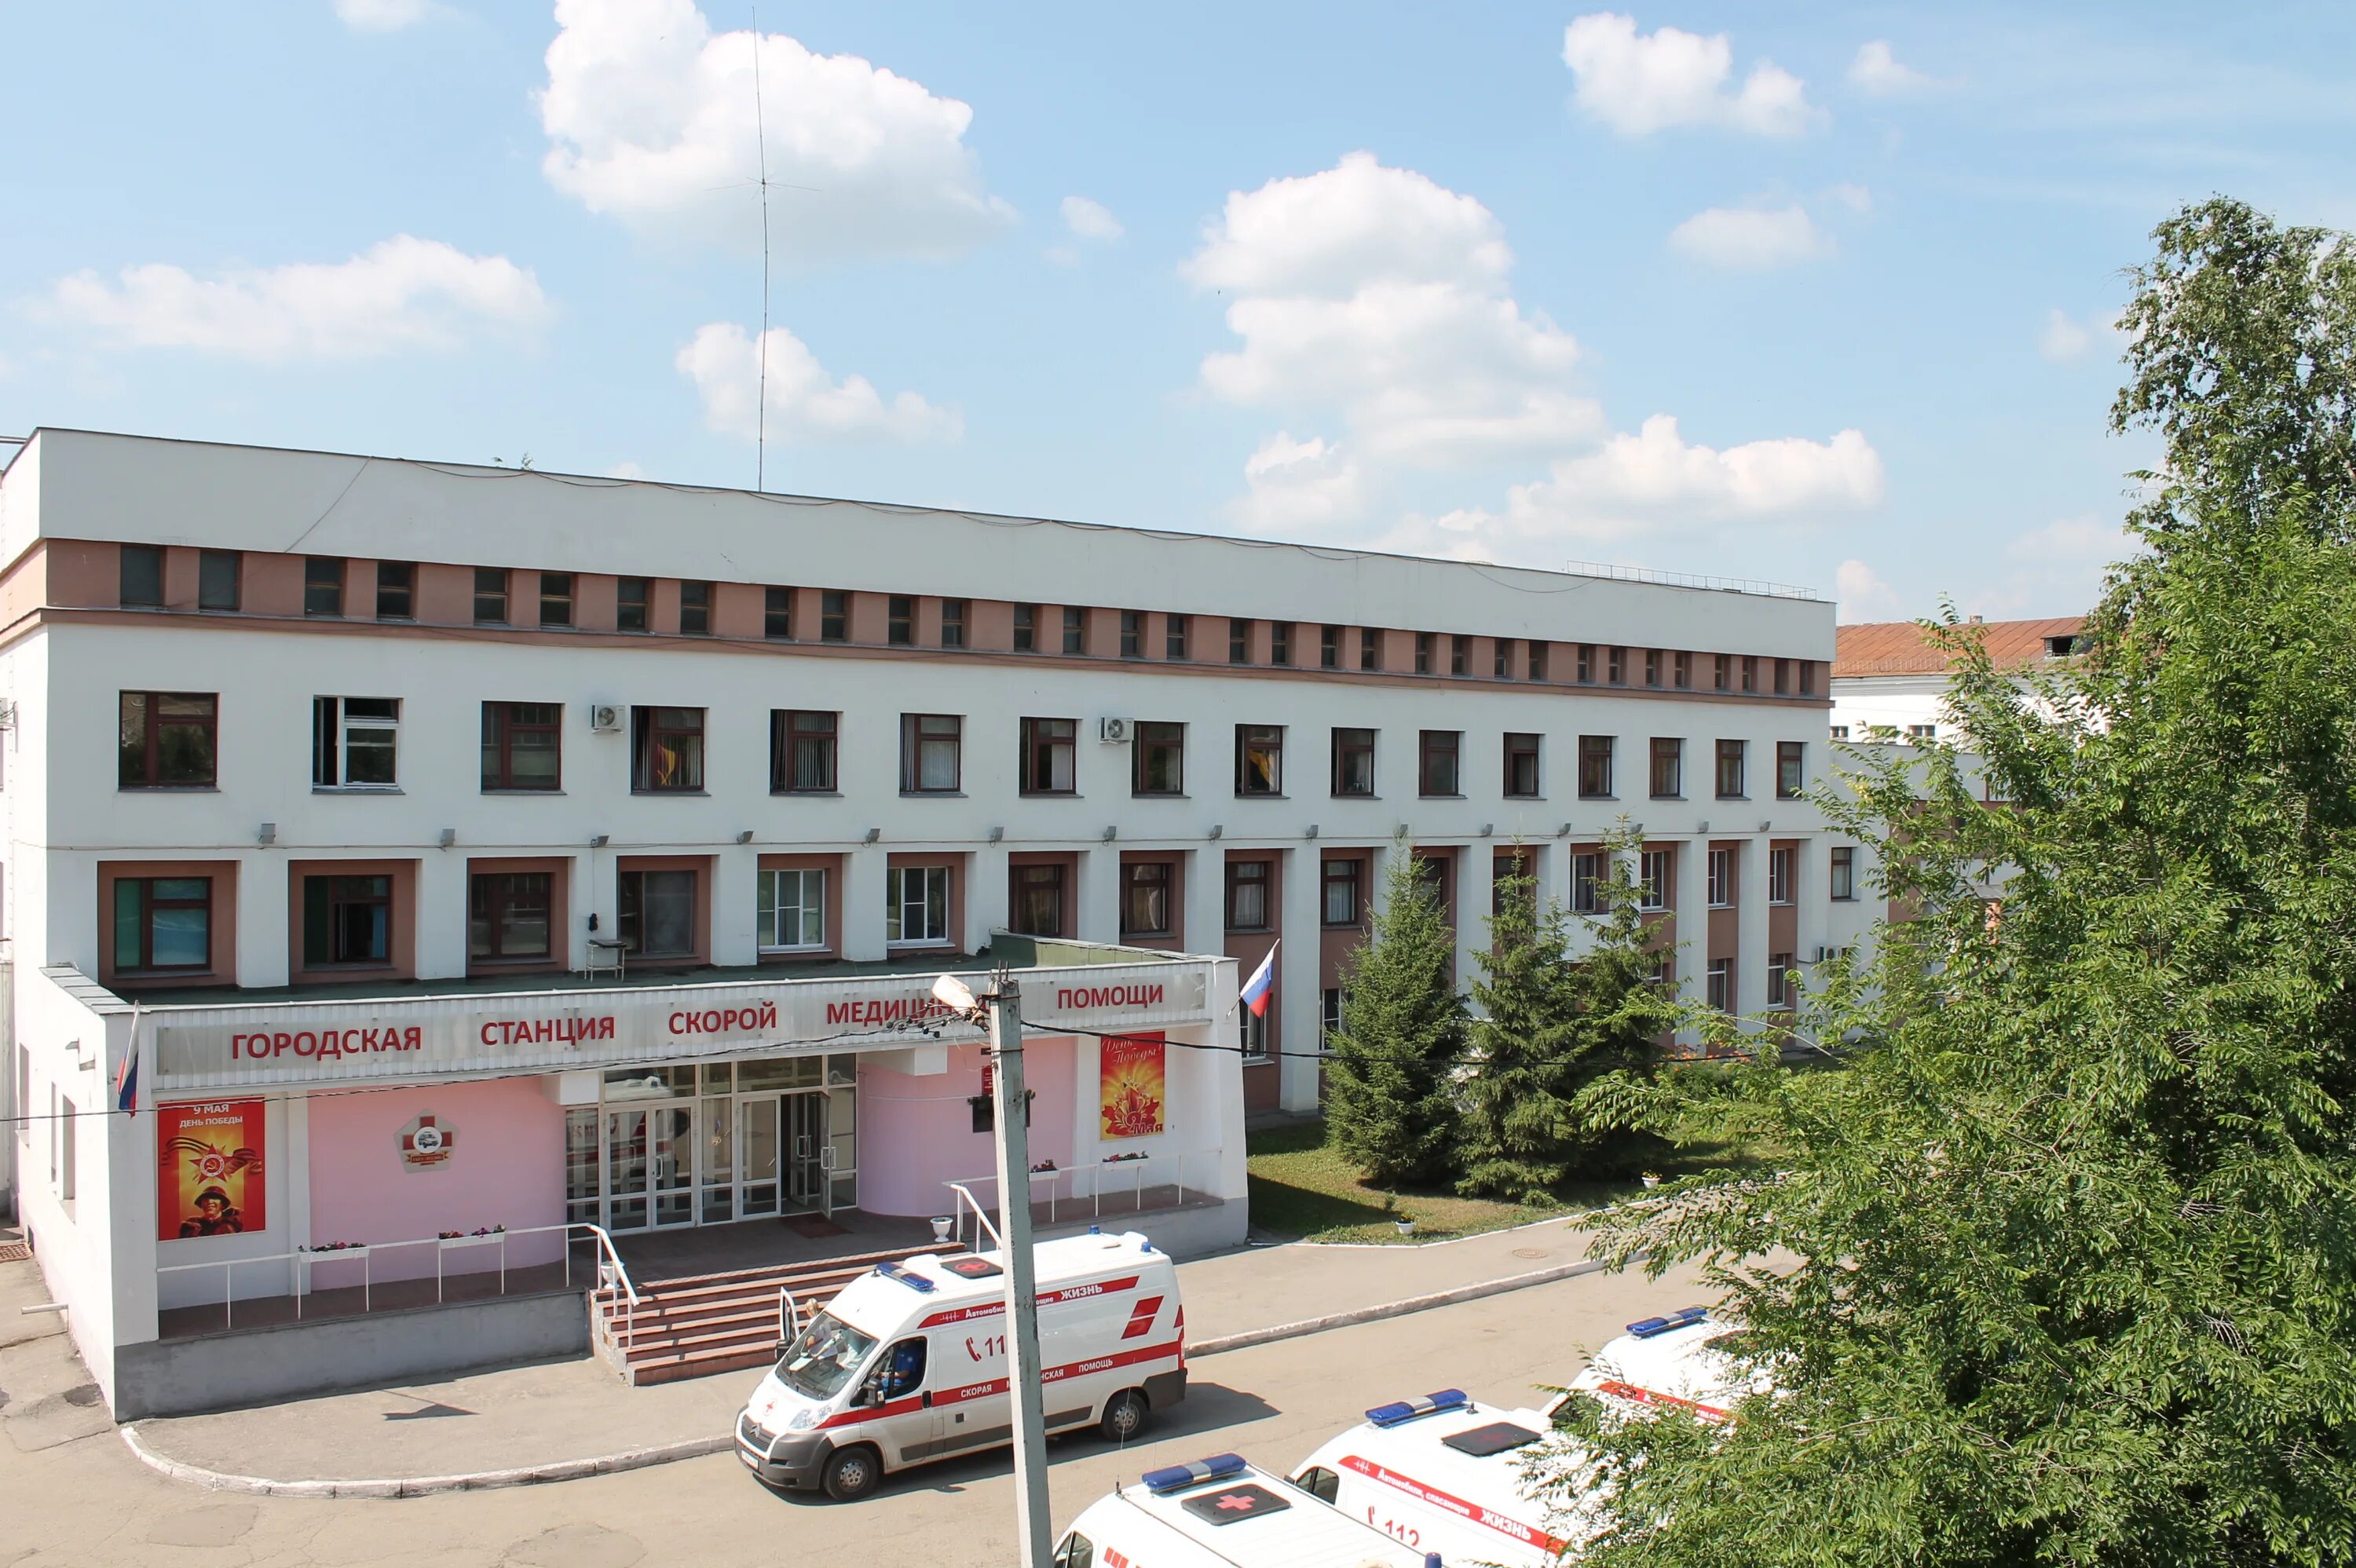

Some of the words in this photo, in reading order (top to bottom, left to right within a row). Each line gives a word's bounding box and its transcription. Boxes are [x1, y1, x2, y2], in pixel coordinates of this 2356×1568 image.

[232, 1027, 422, 1061] ГОРОДСКАЯ
[481, 1017, 615, 1046] СТАНЦИЯ
[668, 1001, 777, 1035] СКОРОЙ
[1057, 985, 1163, 1009] ПОМОЩИ
[179, 1119, 203, 1128] ДЕНЬ
[205, 1116, 243, 1125] ПОБЕДЫ
[193, 1106, 202, 1115] 9
[204, 1103, 229, 1114] МАЯ
[1125, 1110, 1143, 1132] 9
[965, 1306, 1005, 1318] Автомобил
[1060, 1285, 1103, 1300] ЖИЗНЬ
[984, 1335, 1005, 1357] 11
[961, 1384, 992, 1398] СКОРАЯ
[1078, 1358, 1114, 1373] ПОМОЩЬ
[1479, 1509, 1532, 1541] ЖИЗНЬ
